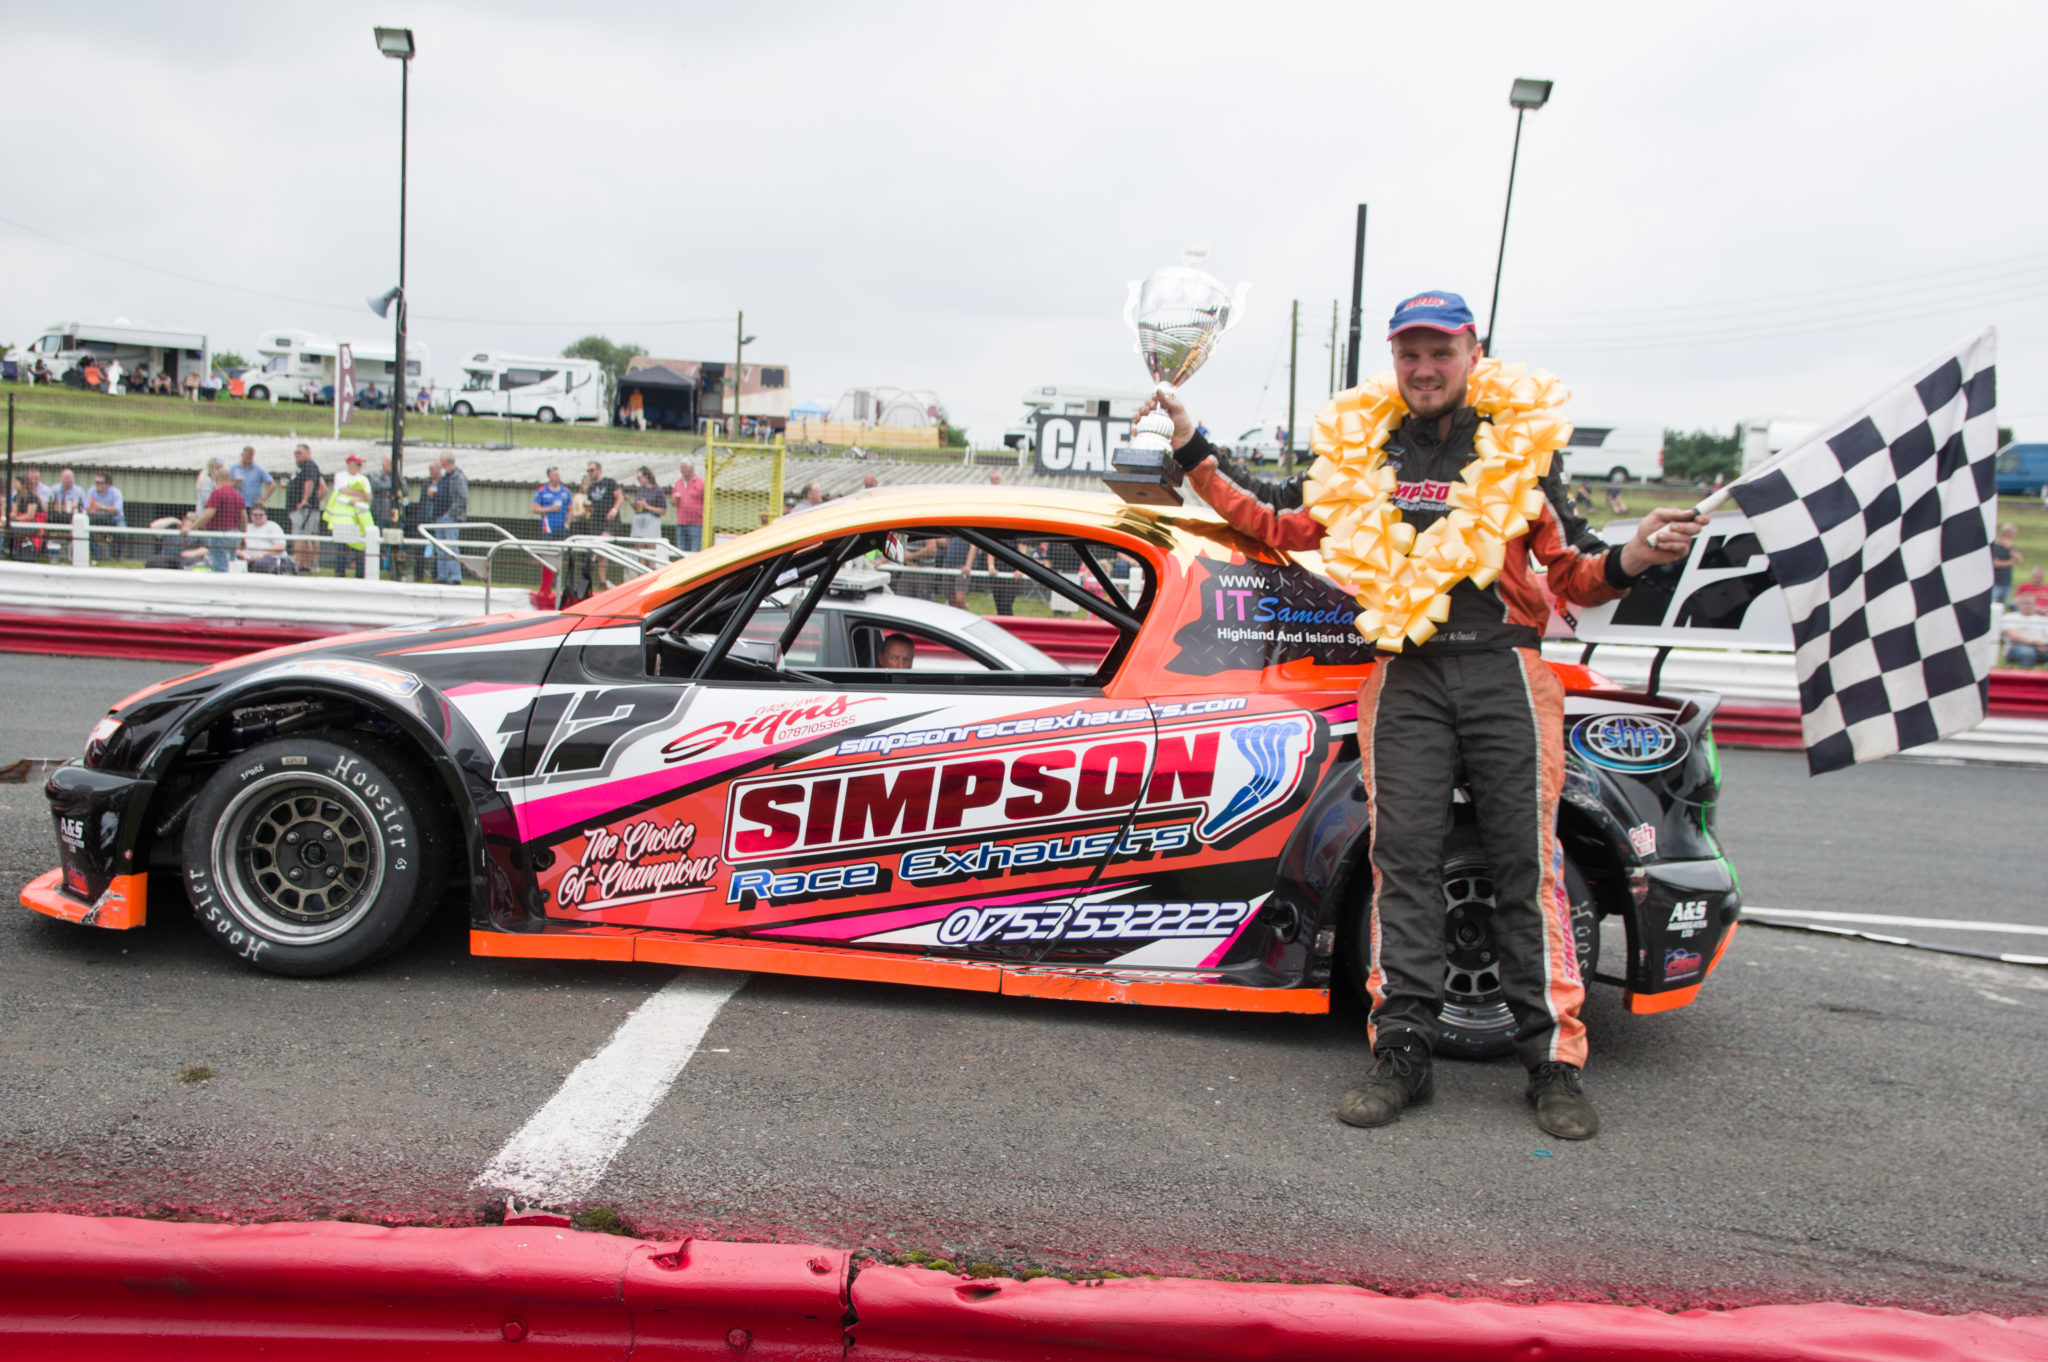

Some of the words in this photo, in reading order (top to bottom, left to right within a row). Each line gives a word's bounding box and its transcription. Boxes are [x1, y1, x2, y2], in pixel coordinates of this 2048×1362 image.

[1041, 418, 1131, 472] CAF
[1215, 589, 1253, 621] IT
[1253, 596, 1355, 625] Sameda
[1219, 575, 1270, 590] www.
[1217, 628, 1275, 642] Highland
[1277, 630, 1302, 643] And
[1306, 632, 1345, 644] Island
[661, 695, 888, 763] Signs
[836, 697, 1247, 757] simpsonraceexhausts.com
[1602, 718, 1660, 757] shp
[328, 755, 407, 848] Hoosier
[735, 731, 1221, 852] SIMPSON
[581, 827, 619, 867] The
[623, 820, 695, 861] Choice
[727, 863, 878, 904] Race
[900, 824, 1191, 880] Exhausts
[558, 866, 596, 905] Of
[599, 854, 719, 899] Champions
[1669, 901, 1708, 922] A&S
